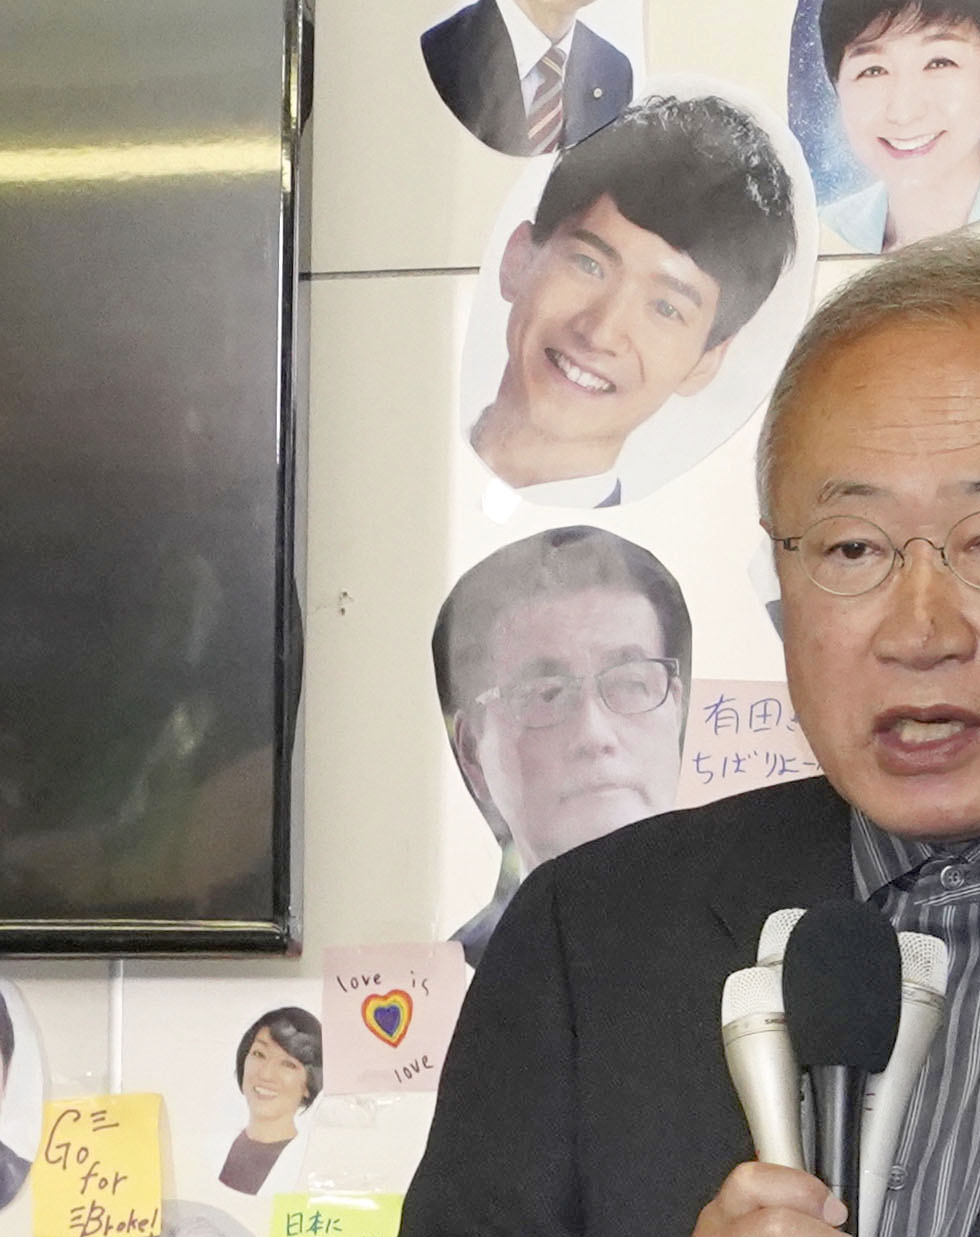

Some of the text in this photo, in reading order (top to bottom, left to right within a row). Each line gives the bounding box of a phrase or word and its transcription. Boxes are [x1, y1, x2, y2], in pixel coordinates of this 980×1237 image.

[336, 970, 429, 996] love is
[394, 1055, 434, 1083] love
[45, 1109, 89, 1170] Go
[80, 1160, 128, 1195] for
[286, 1210, 342, 1237] 日本に
